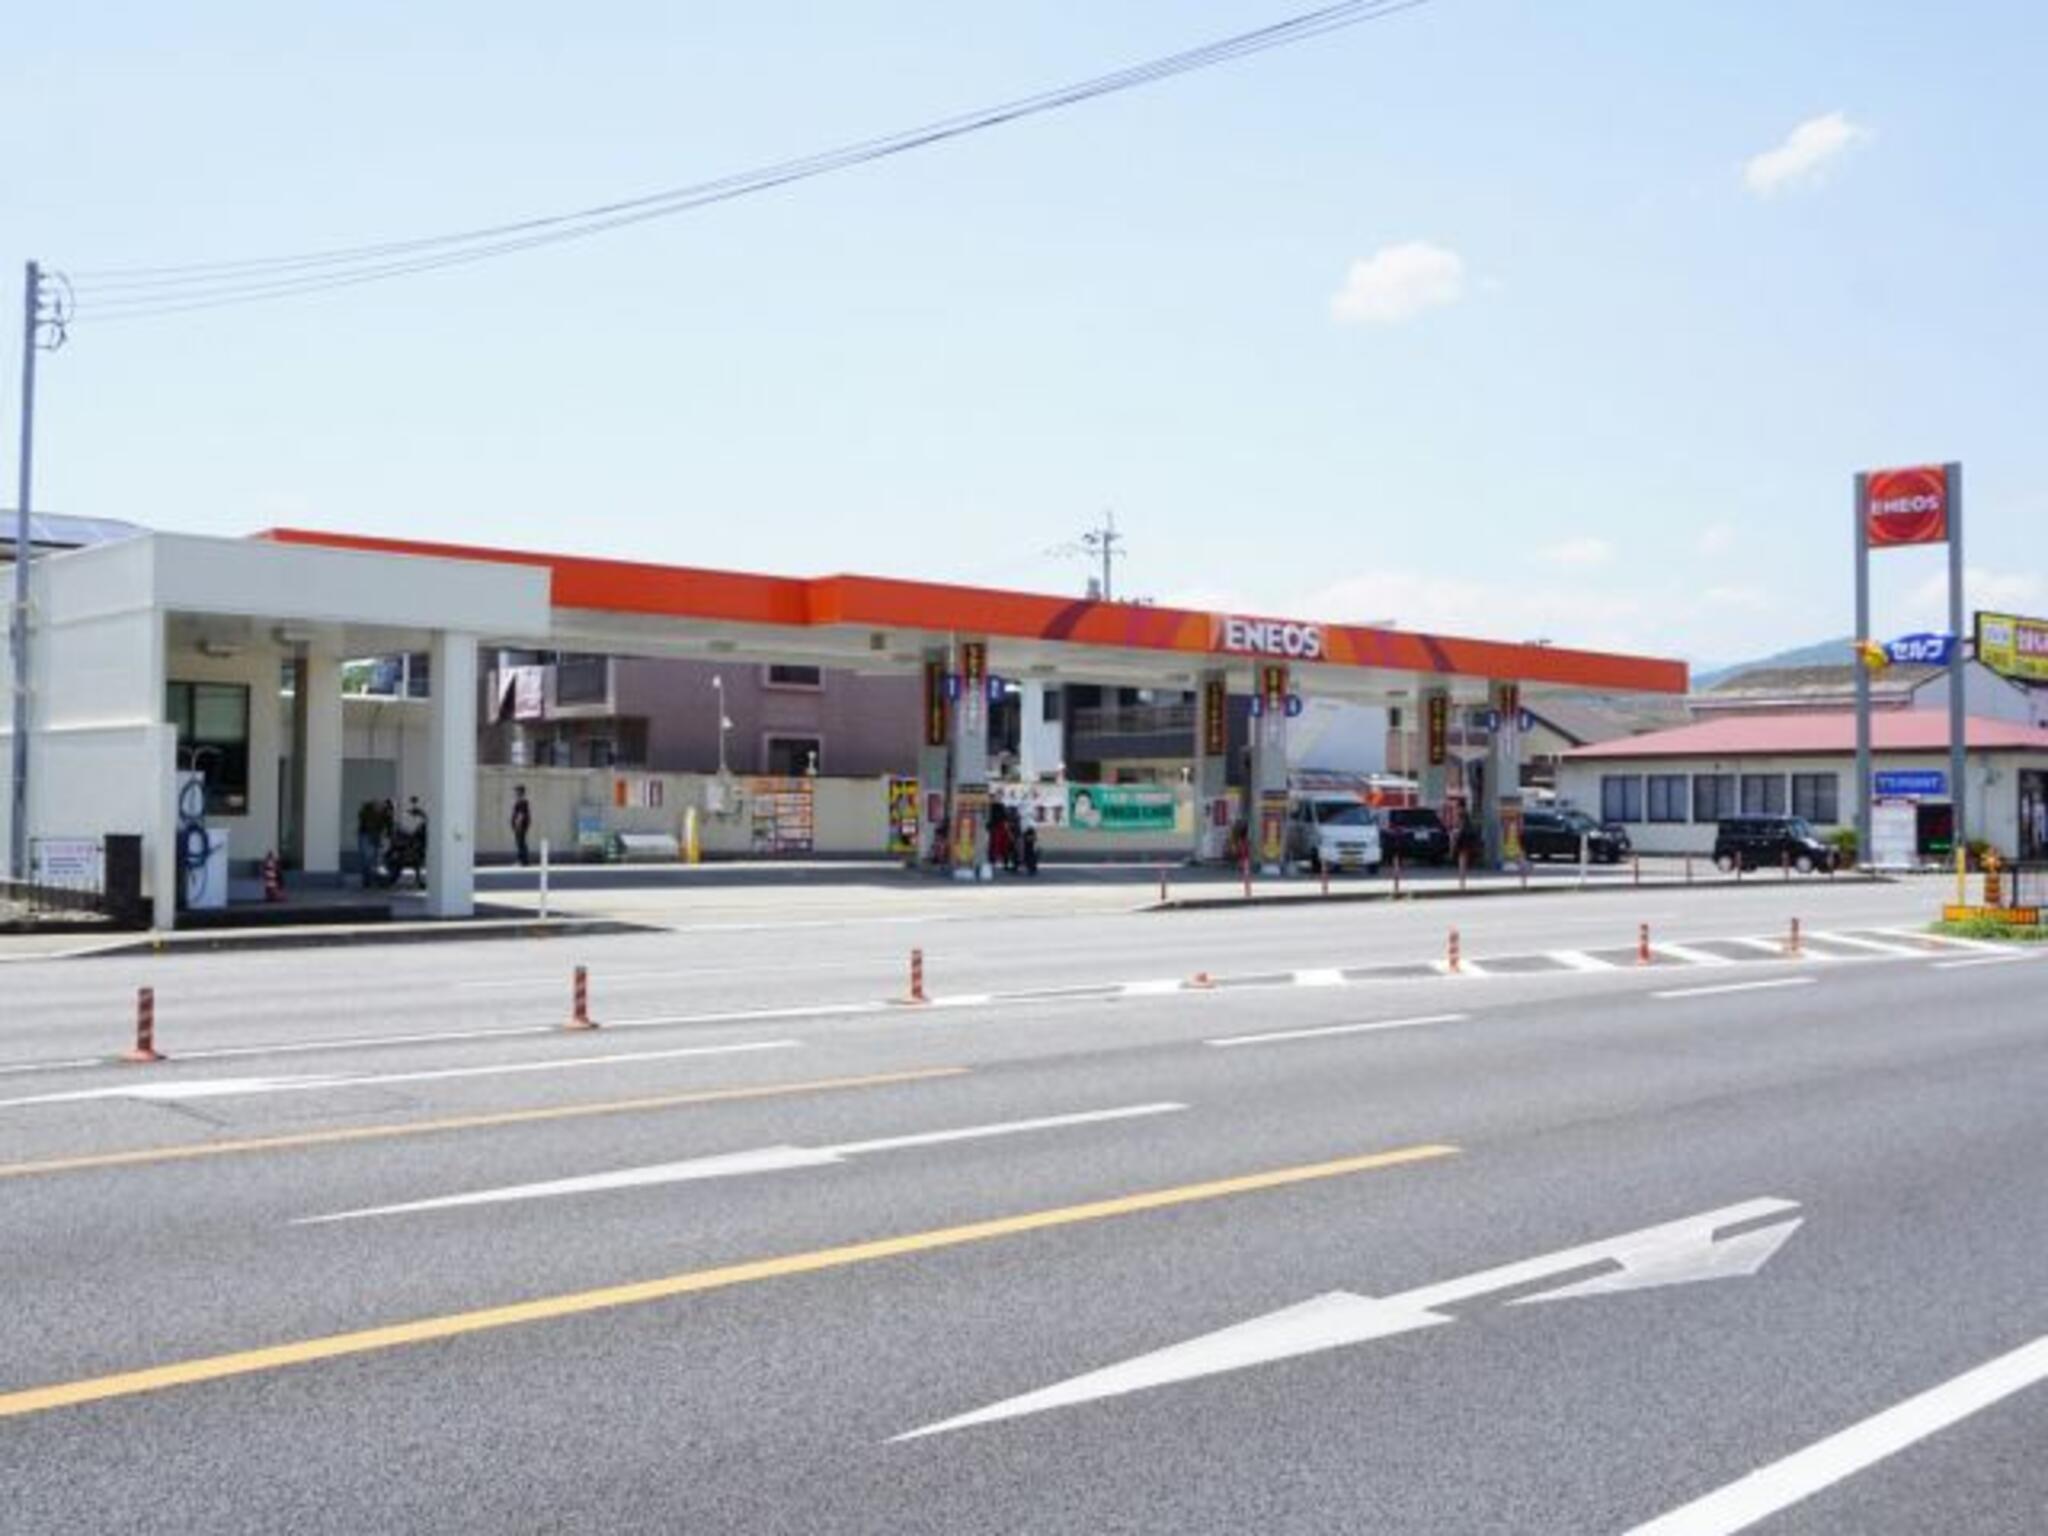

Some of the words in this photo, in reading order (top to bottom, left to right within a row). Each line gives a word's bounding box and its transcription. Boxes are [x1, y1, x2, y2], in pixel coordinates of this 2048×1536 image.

[1871, 496, 1938, 515] ENEOS
[1225, 620, 1320, 658] ENEOS
[1890, 639, 1944, 661] セルフ
